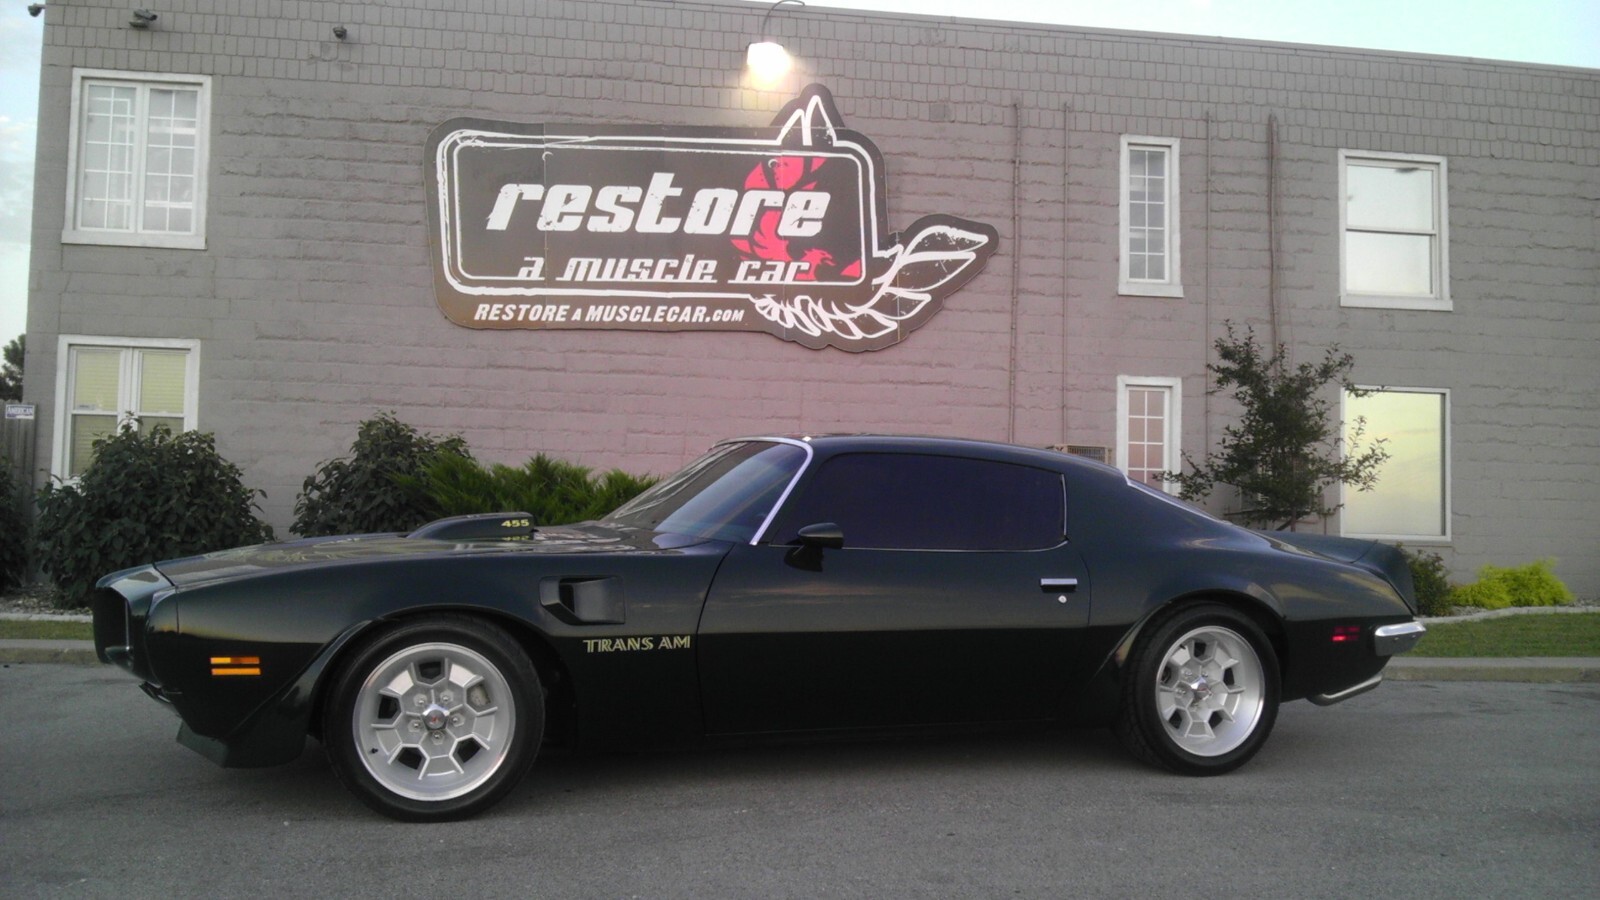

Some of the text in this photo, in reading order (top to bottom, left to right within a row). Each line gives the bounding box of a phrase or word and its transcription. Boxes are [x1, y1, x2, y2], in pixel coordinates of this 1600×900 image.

[486, 172, 831, 237] restore
[518, 254, 810, 285] a muscle car
[474, 303, 745, 323] RESTORE A MUSCLECAR.COM
[7, 406, 33, 415] AMERICAN
[501, 519, 529, 527] 455
[583, 635, 691, 653] TRANS AM
